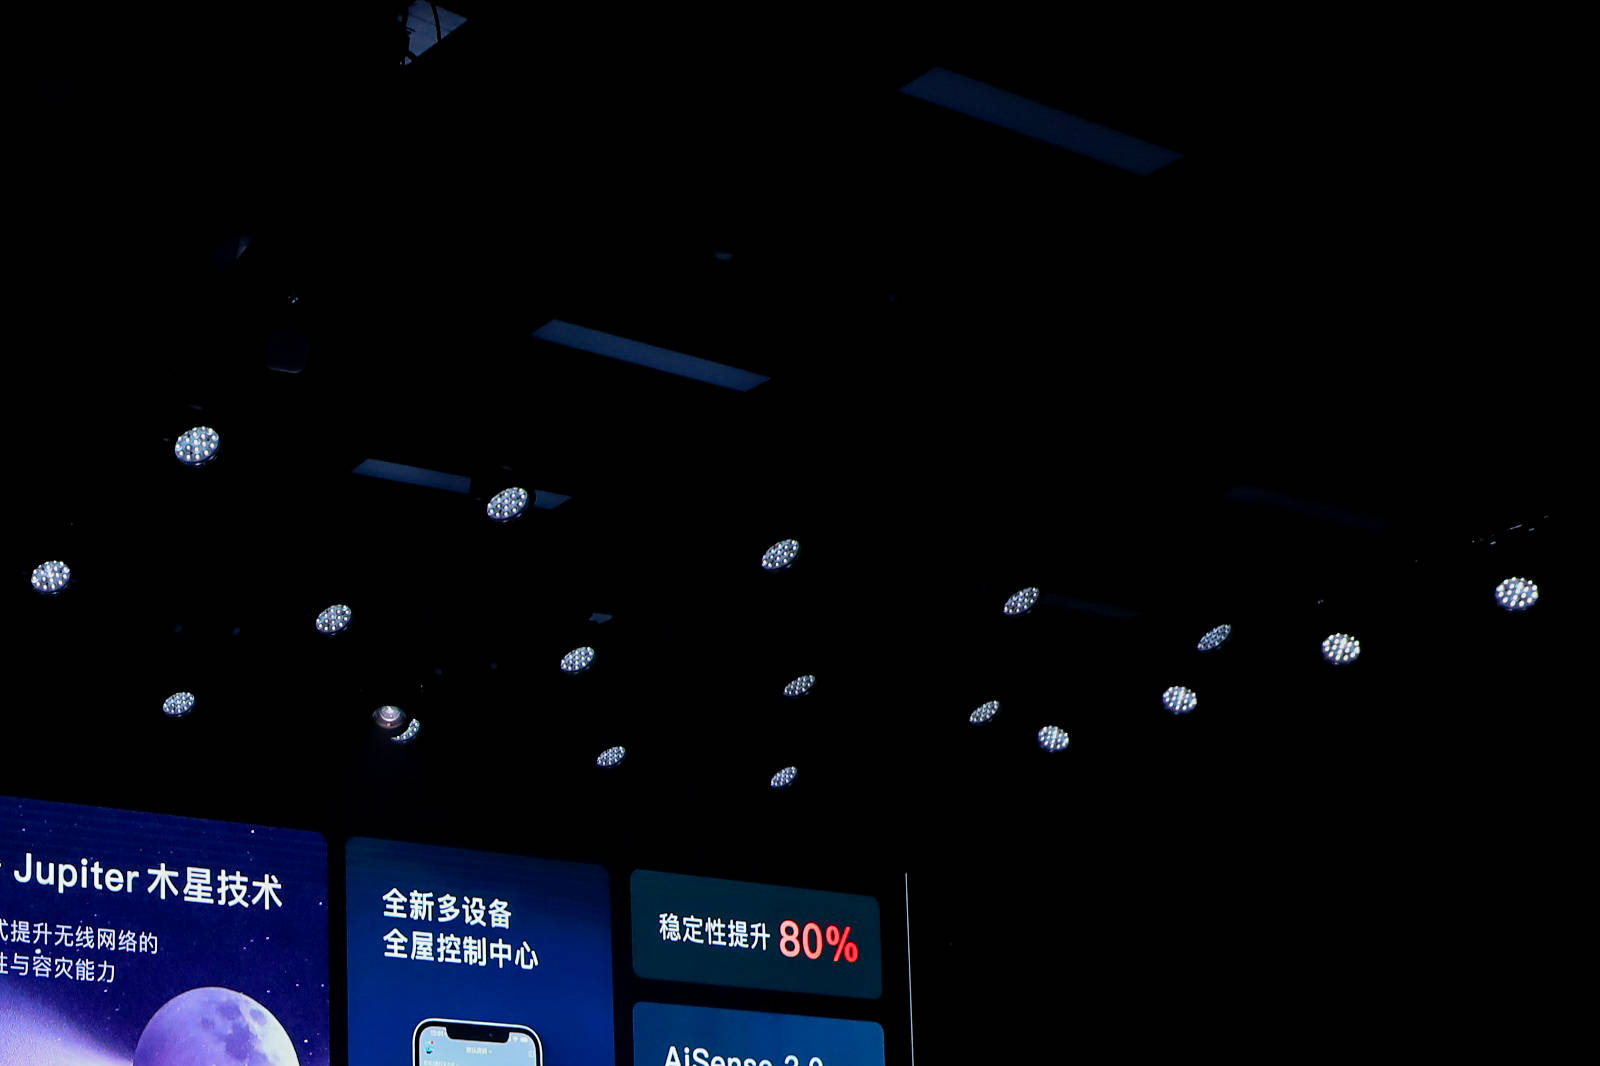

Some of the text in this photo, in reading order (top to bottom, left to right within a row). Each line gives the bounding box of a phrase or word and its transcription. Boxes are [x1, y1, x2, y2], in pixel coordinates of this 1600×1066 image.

[12, 853, 284, 911] Jupiter 木星技术
[382, 887, 512, 930] 全新多设备
[383, 928, 539, 970] 全屋控制中心
[658, 911, 859, 964] 稳定性提升 80%
